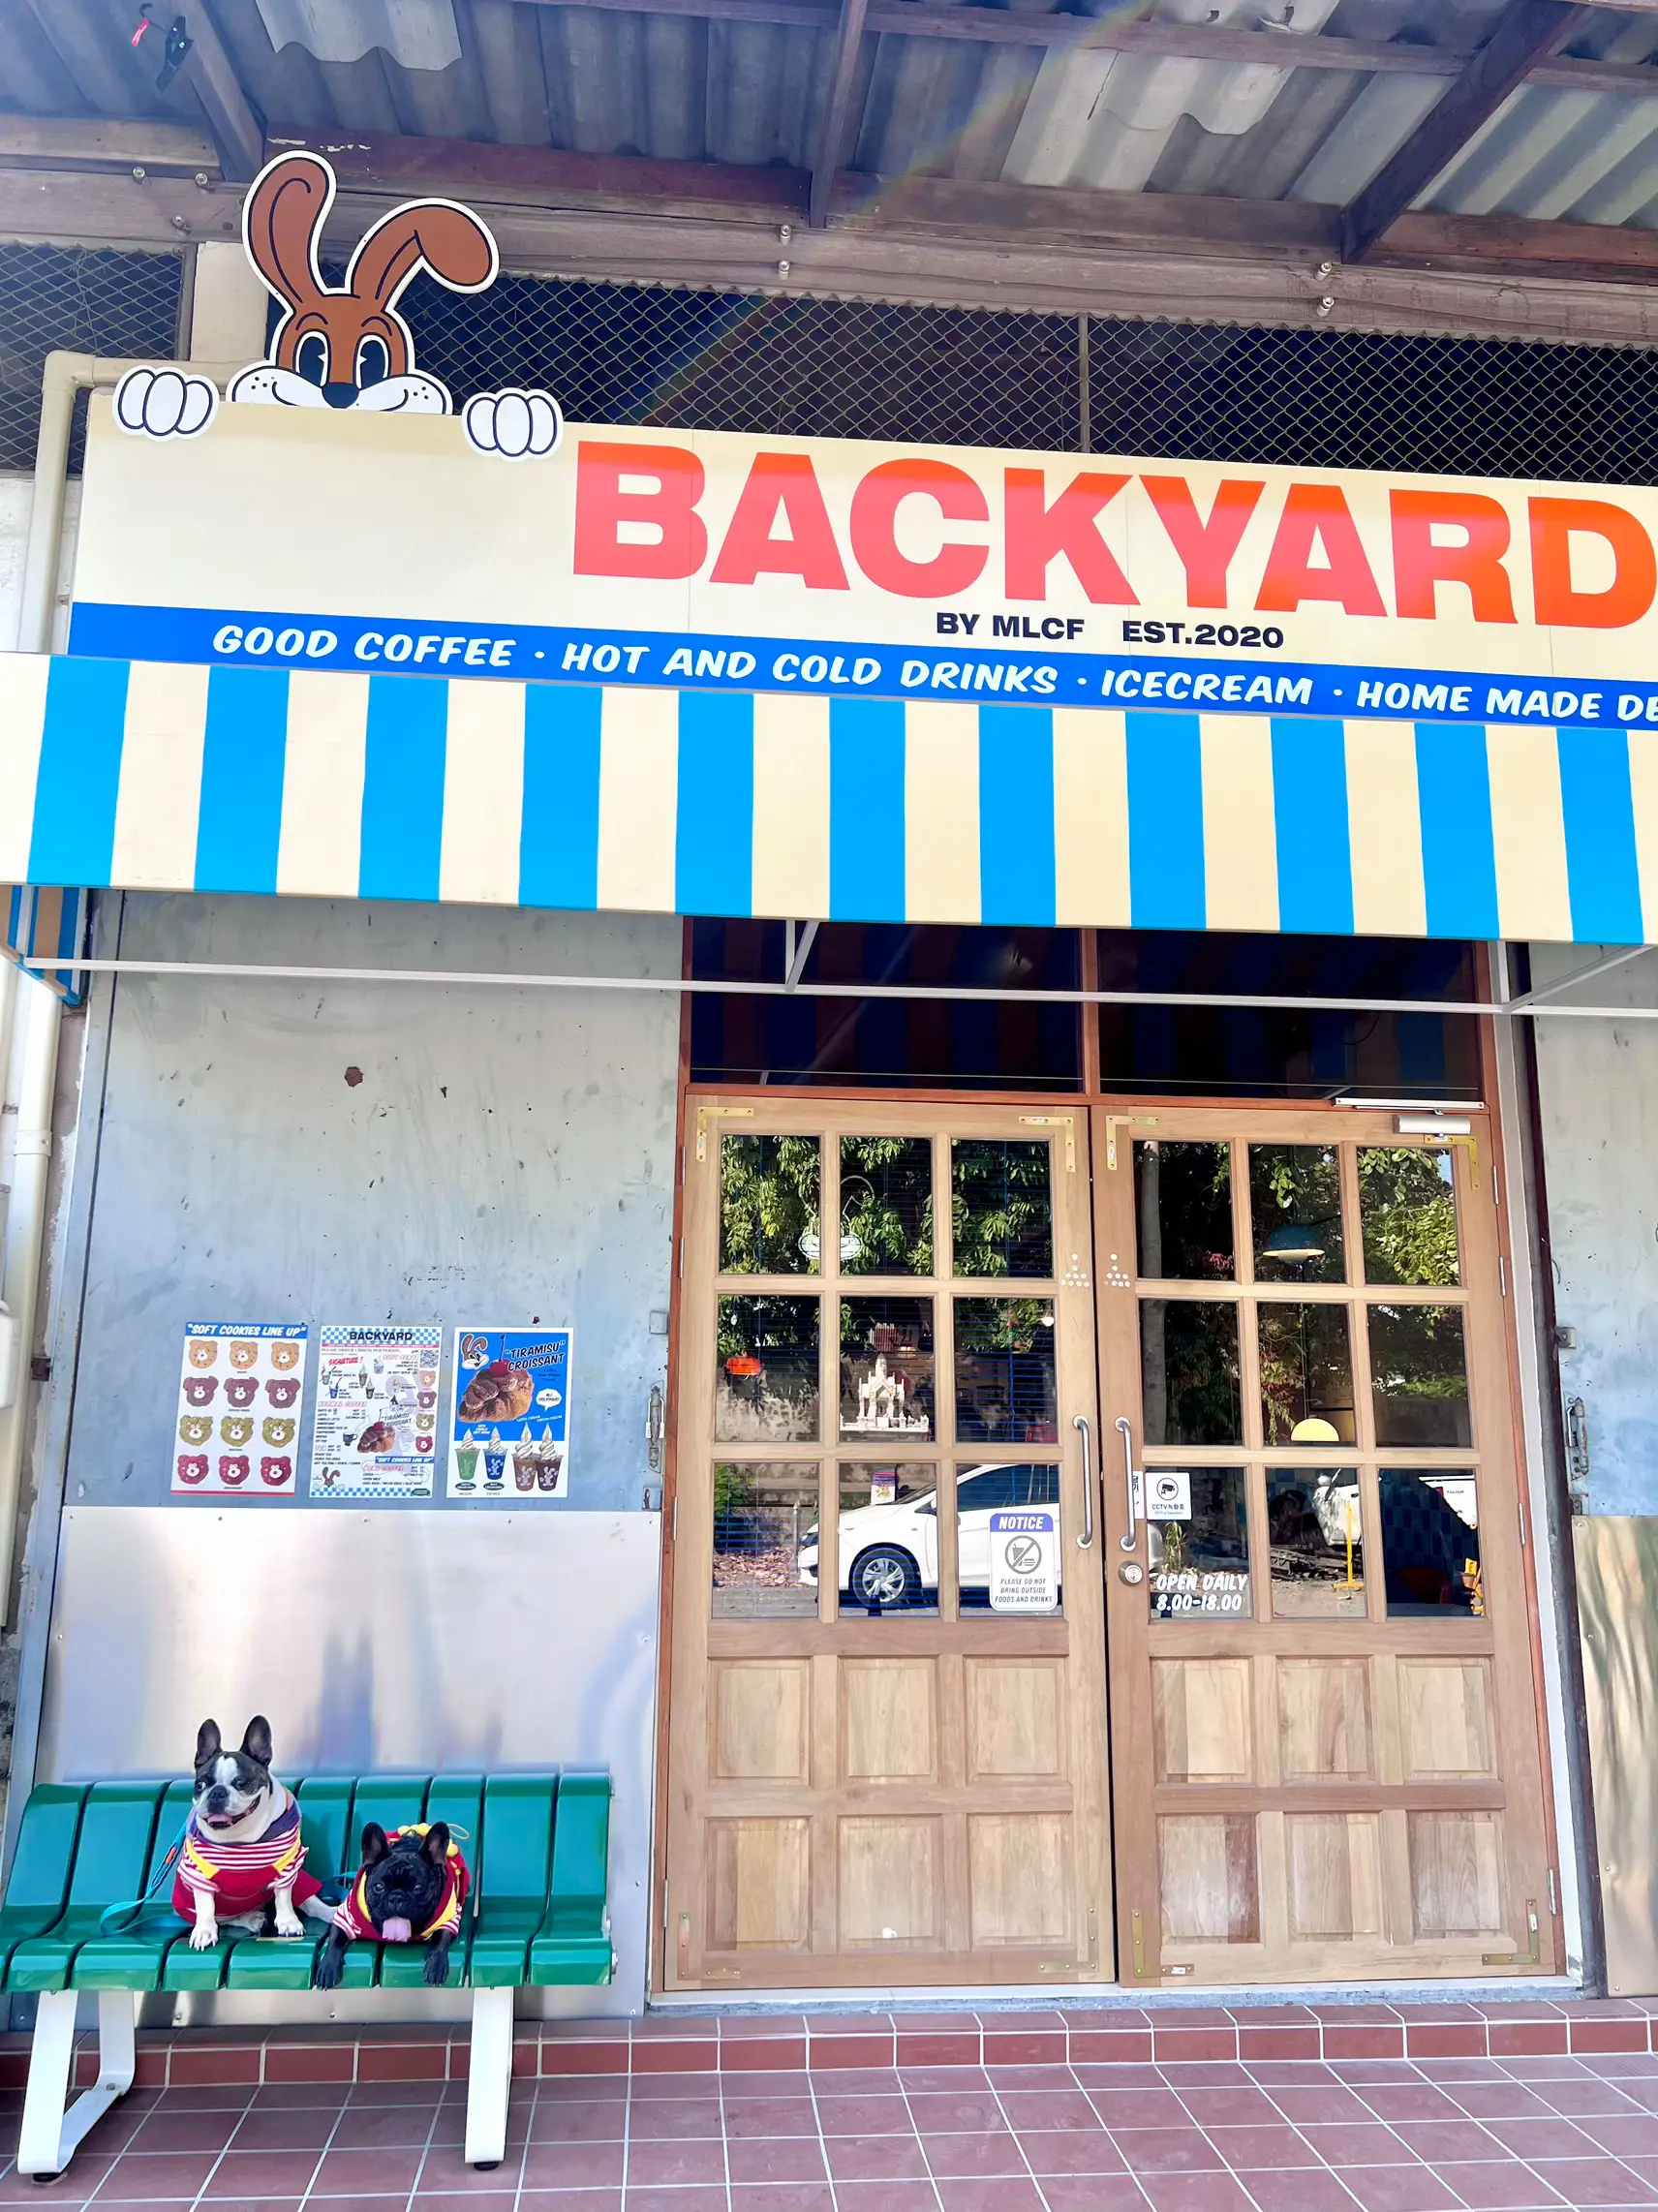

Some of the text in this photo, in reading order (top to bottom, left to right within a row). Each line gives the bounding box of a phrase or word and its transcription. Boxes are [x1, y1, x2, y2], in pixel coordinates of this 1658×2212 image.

[574, 442, 1657, 629] BACKYARD
[936, 612, 1284, 649] BY MLCF EST.2020
[212, 625, 338, 658] GOOD
[353, 631, 517, 667] COFFEE
[561, 642, 651, 674] HOT
[662, 648, 756, 679] AND
[772, 654, 882, 686] COLD
[900, 660, 1059, 694] DRINKS
[1101, 669, 1313, 705] ICECREAM
[1357, 681, 1473, 712] HOME
[1486, 688, 1604, 720] MADE
[219, 1325, 260, 1336] COOKIES
[261, 1326, 285, 1336] LINE
[349, 1332, 414, 1341] BACKYARD
[505, 1340, 566, 1360] "TIRAMISU"
[507, 1353, 565, 1371] CROISSANT
[998, 1516, 1044, 1530] NOTICE
[1155, 1573, 1249, 1592] OPEN DAILY
[1155, 1593, 1243, 1612] 8.00-18.00
